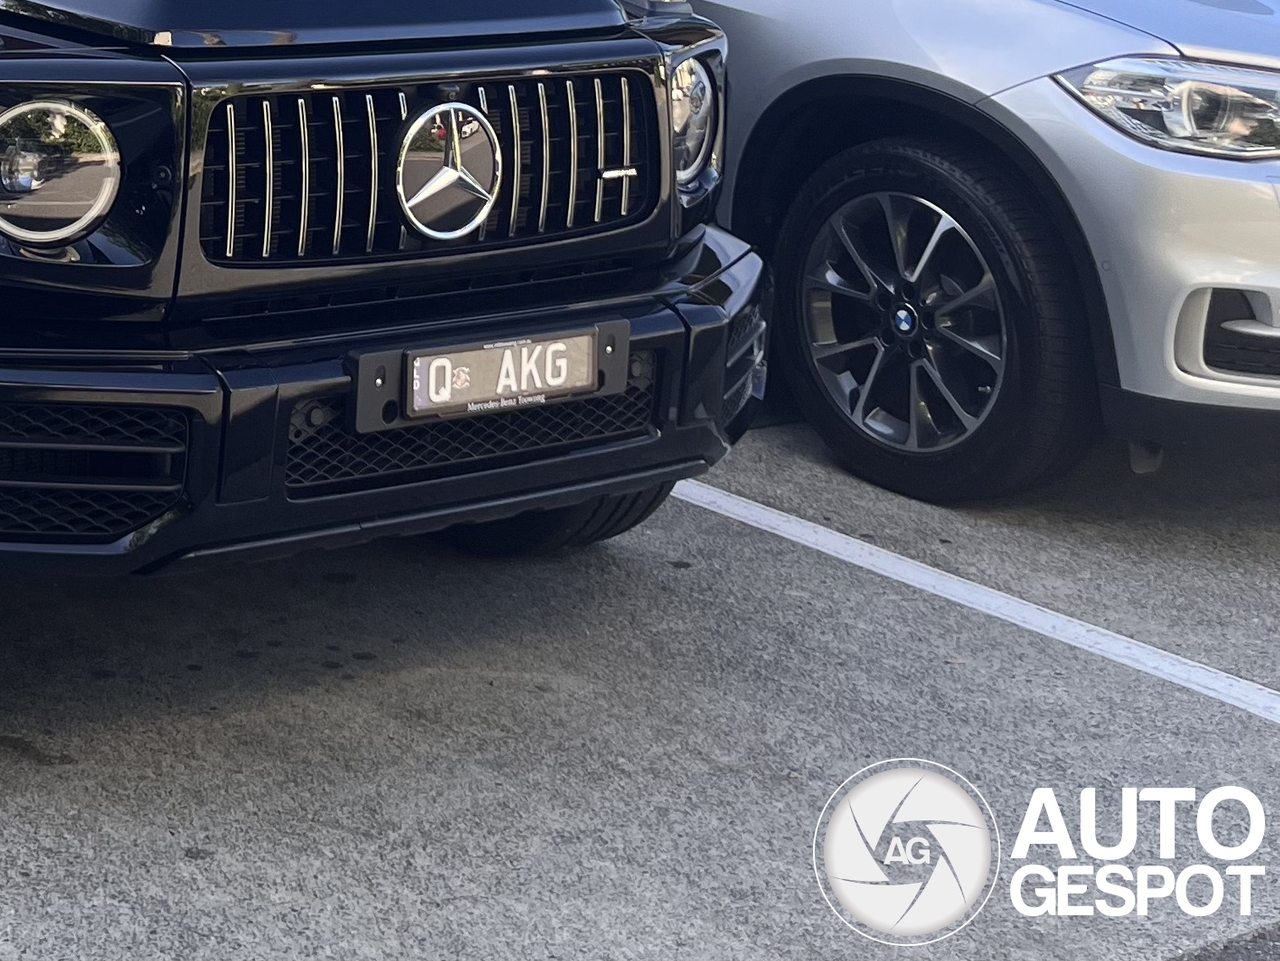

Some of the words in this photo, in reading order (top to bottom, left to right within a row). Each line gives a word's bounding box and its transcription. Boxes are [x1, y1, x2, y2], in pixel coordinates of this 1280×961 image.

[428, 357, 452, 403] Q
[496, 342, 567, 394] AKG
[467, 398, 516, 411] Mercedes-Benz
